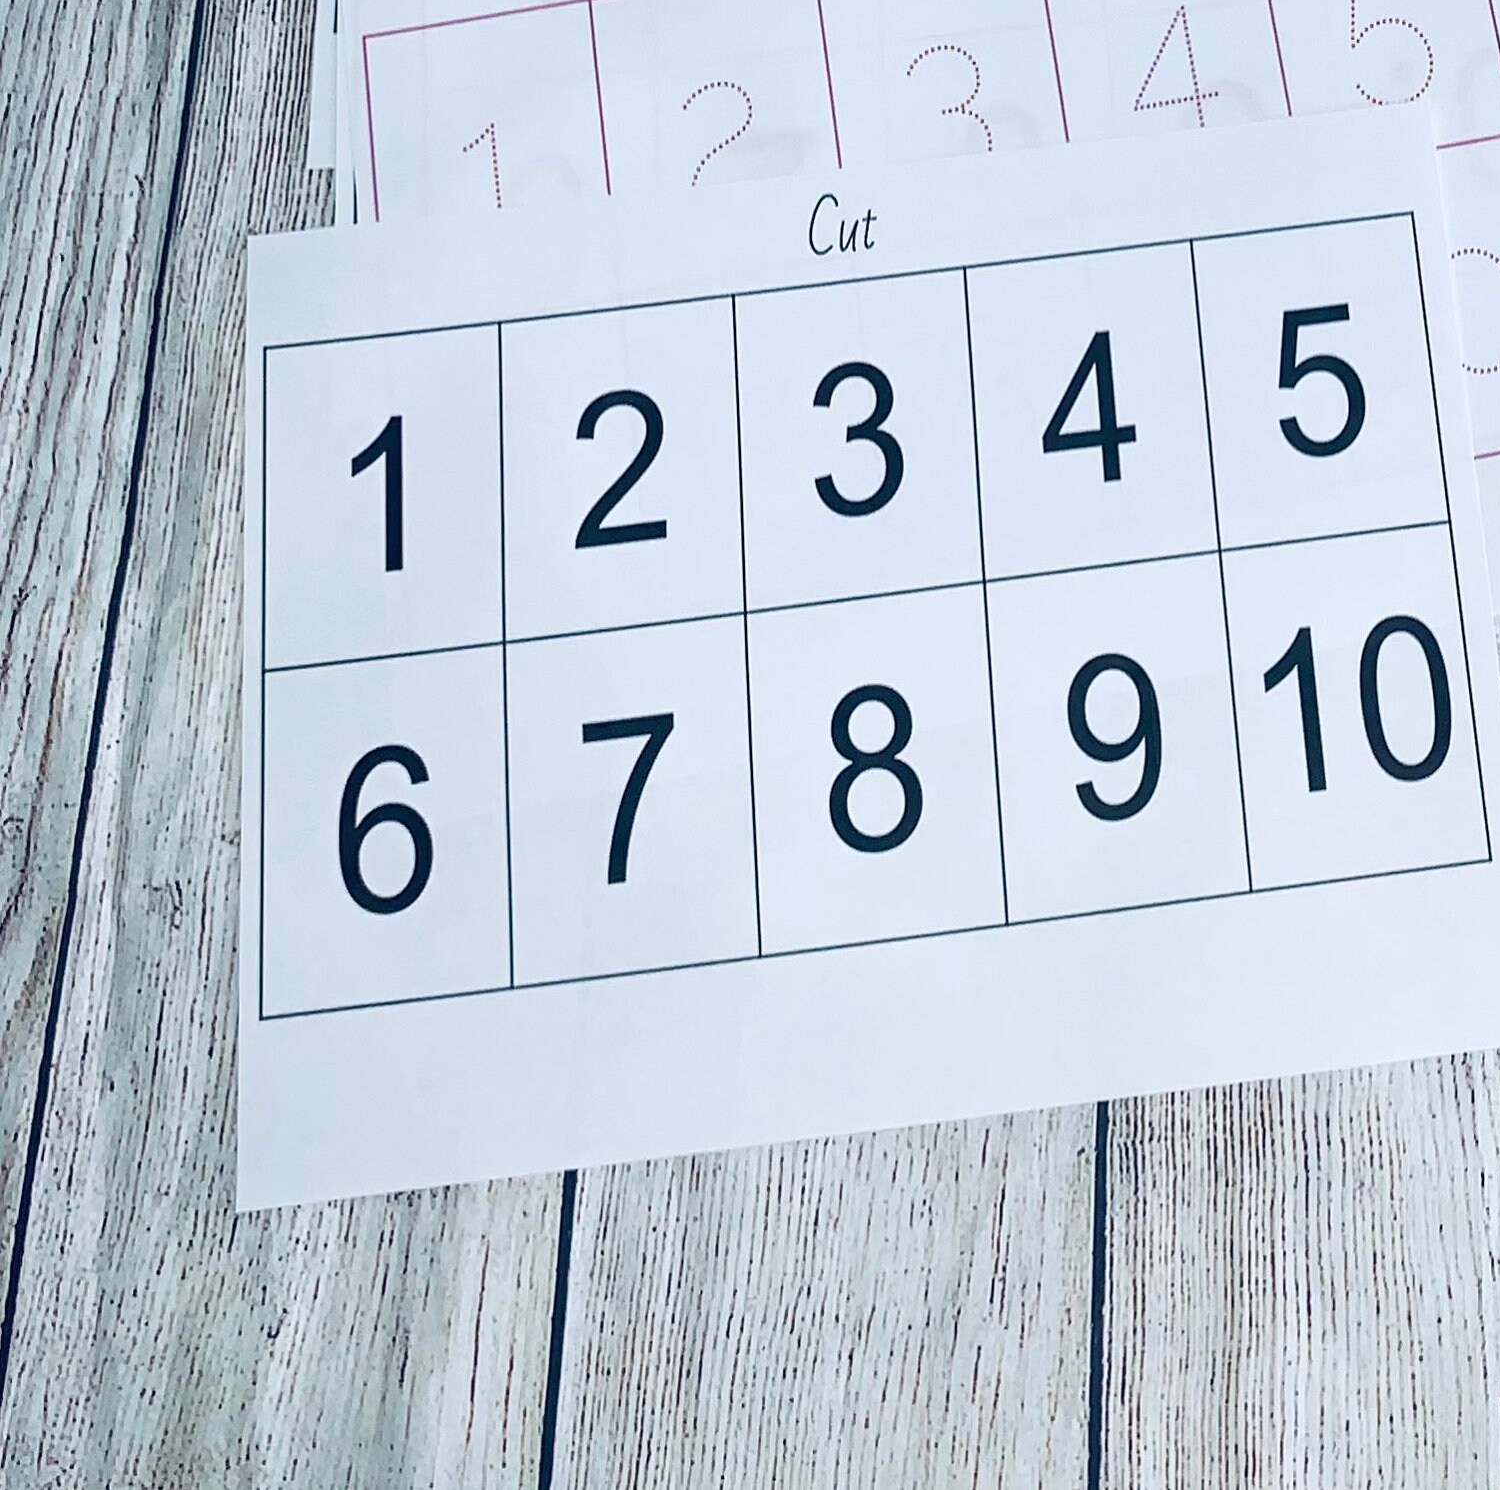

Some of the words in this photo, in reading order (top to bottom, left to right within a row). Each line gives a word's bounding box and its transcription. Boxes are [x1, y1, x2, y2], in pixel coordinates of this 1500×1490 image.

[682, 81, 753, 187] 2
[906, 44, 993, 152] 3
[1134, 5, 1219, 128] 4
[808, 193, 878, 256] Cut
[350, 414, 404, 573] 1
[574, 389, 668, 550] 2
[812, 361, 905, 518] 3
[1041, 330, 1137, 483] 4
[1278, 302, 1366, 458] 5
[338, 744, 434, 916] 6
[581, 712, 675, 886] 7
[828, 684, 924, 854] 8
[1066, 653, 1163, 822] 9
[1263, 613, 1454, 793] 10
